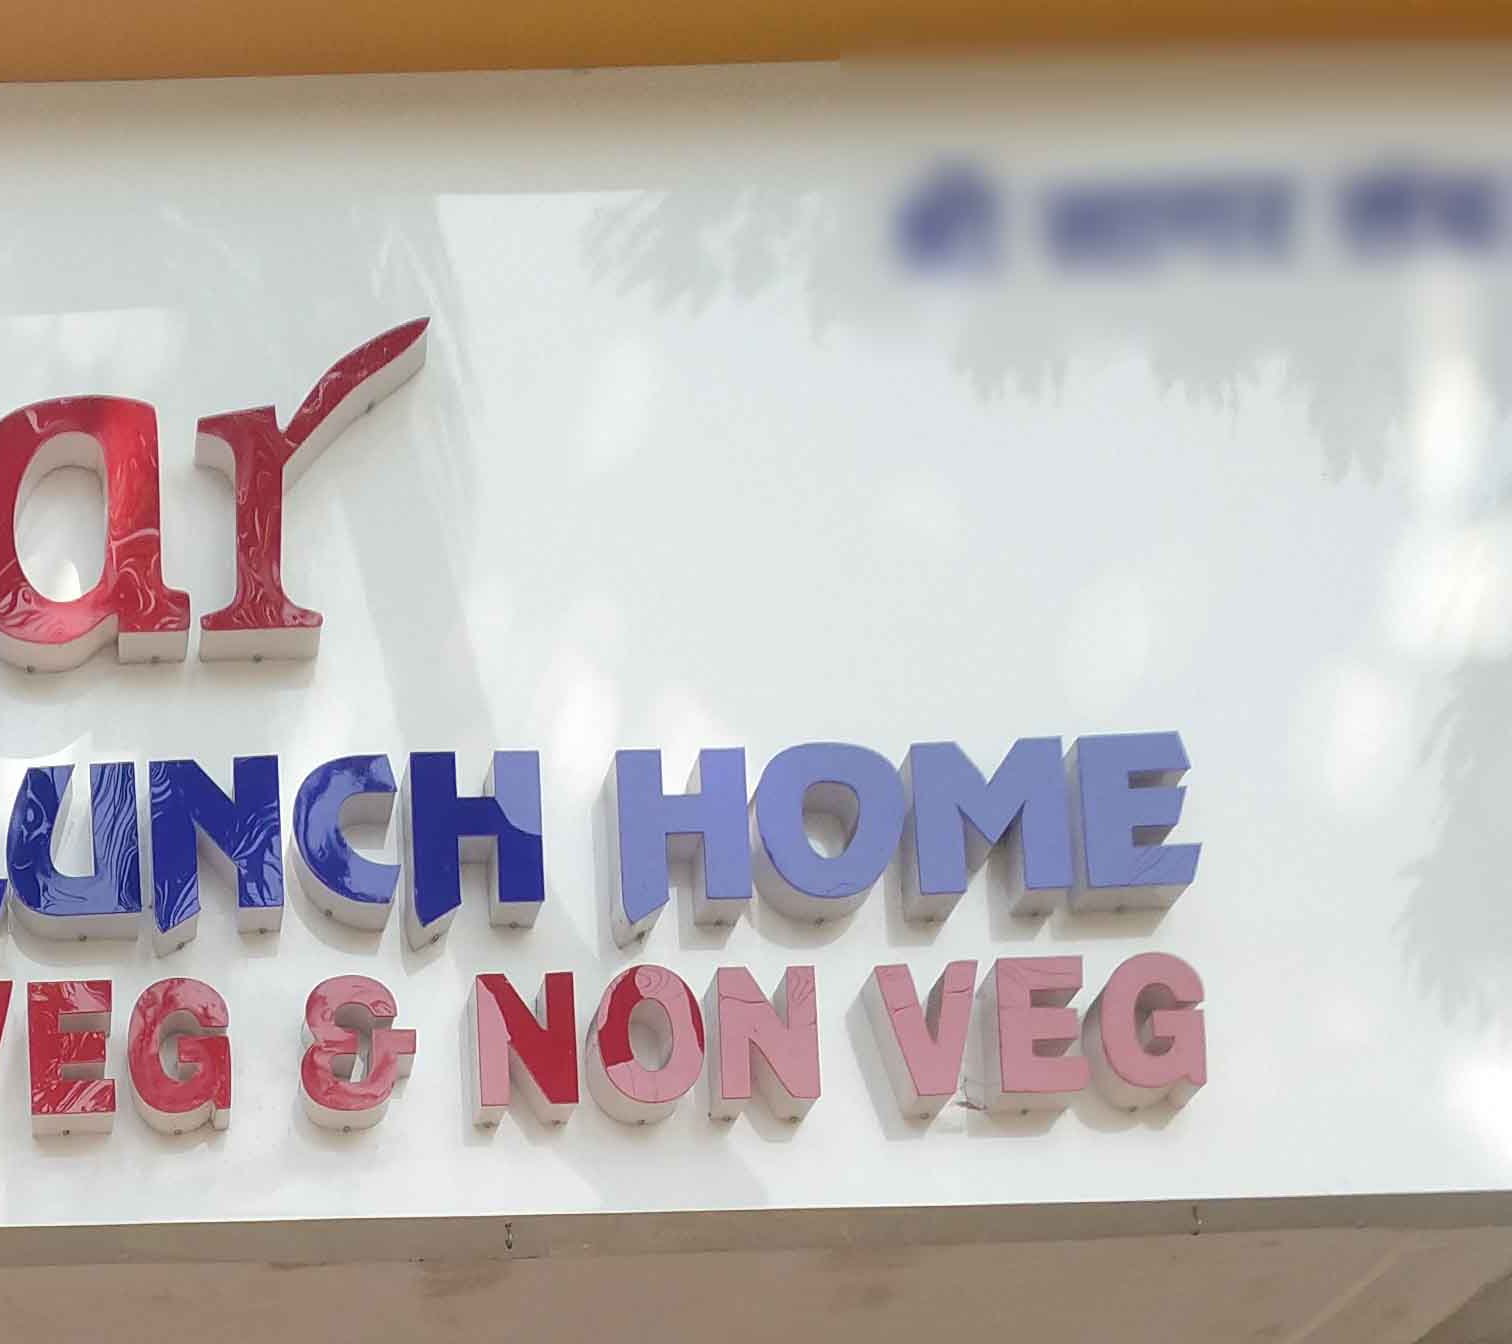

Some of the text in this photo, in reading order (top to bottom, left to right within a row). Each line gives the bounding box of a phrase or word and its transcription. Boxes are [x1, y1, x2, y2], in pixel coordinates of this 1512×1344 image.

[614, 730, 1202, 938] HOME
[300, 975, 417, 1129] &
[476, 964, 822, 1126] NON
[872, 951, 1208, 1119] VEG
